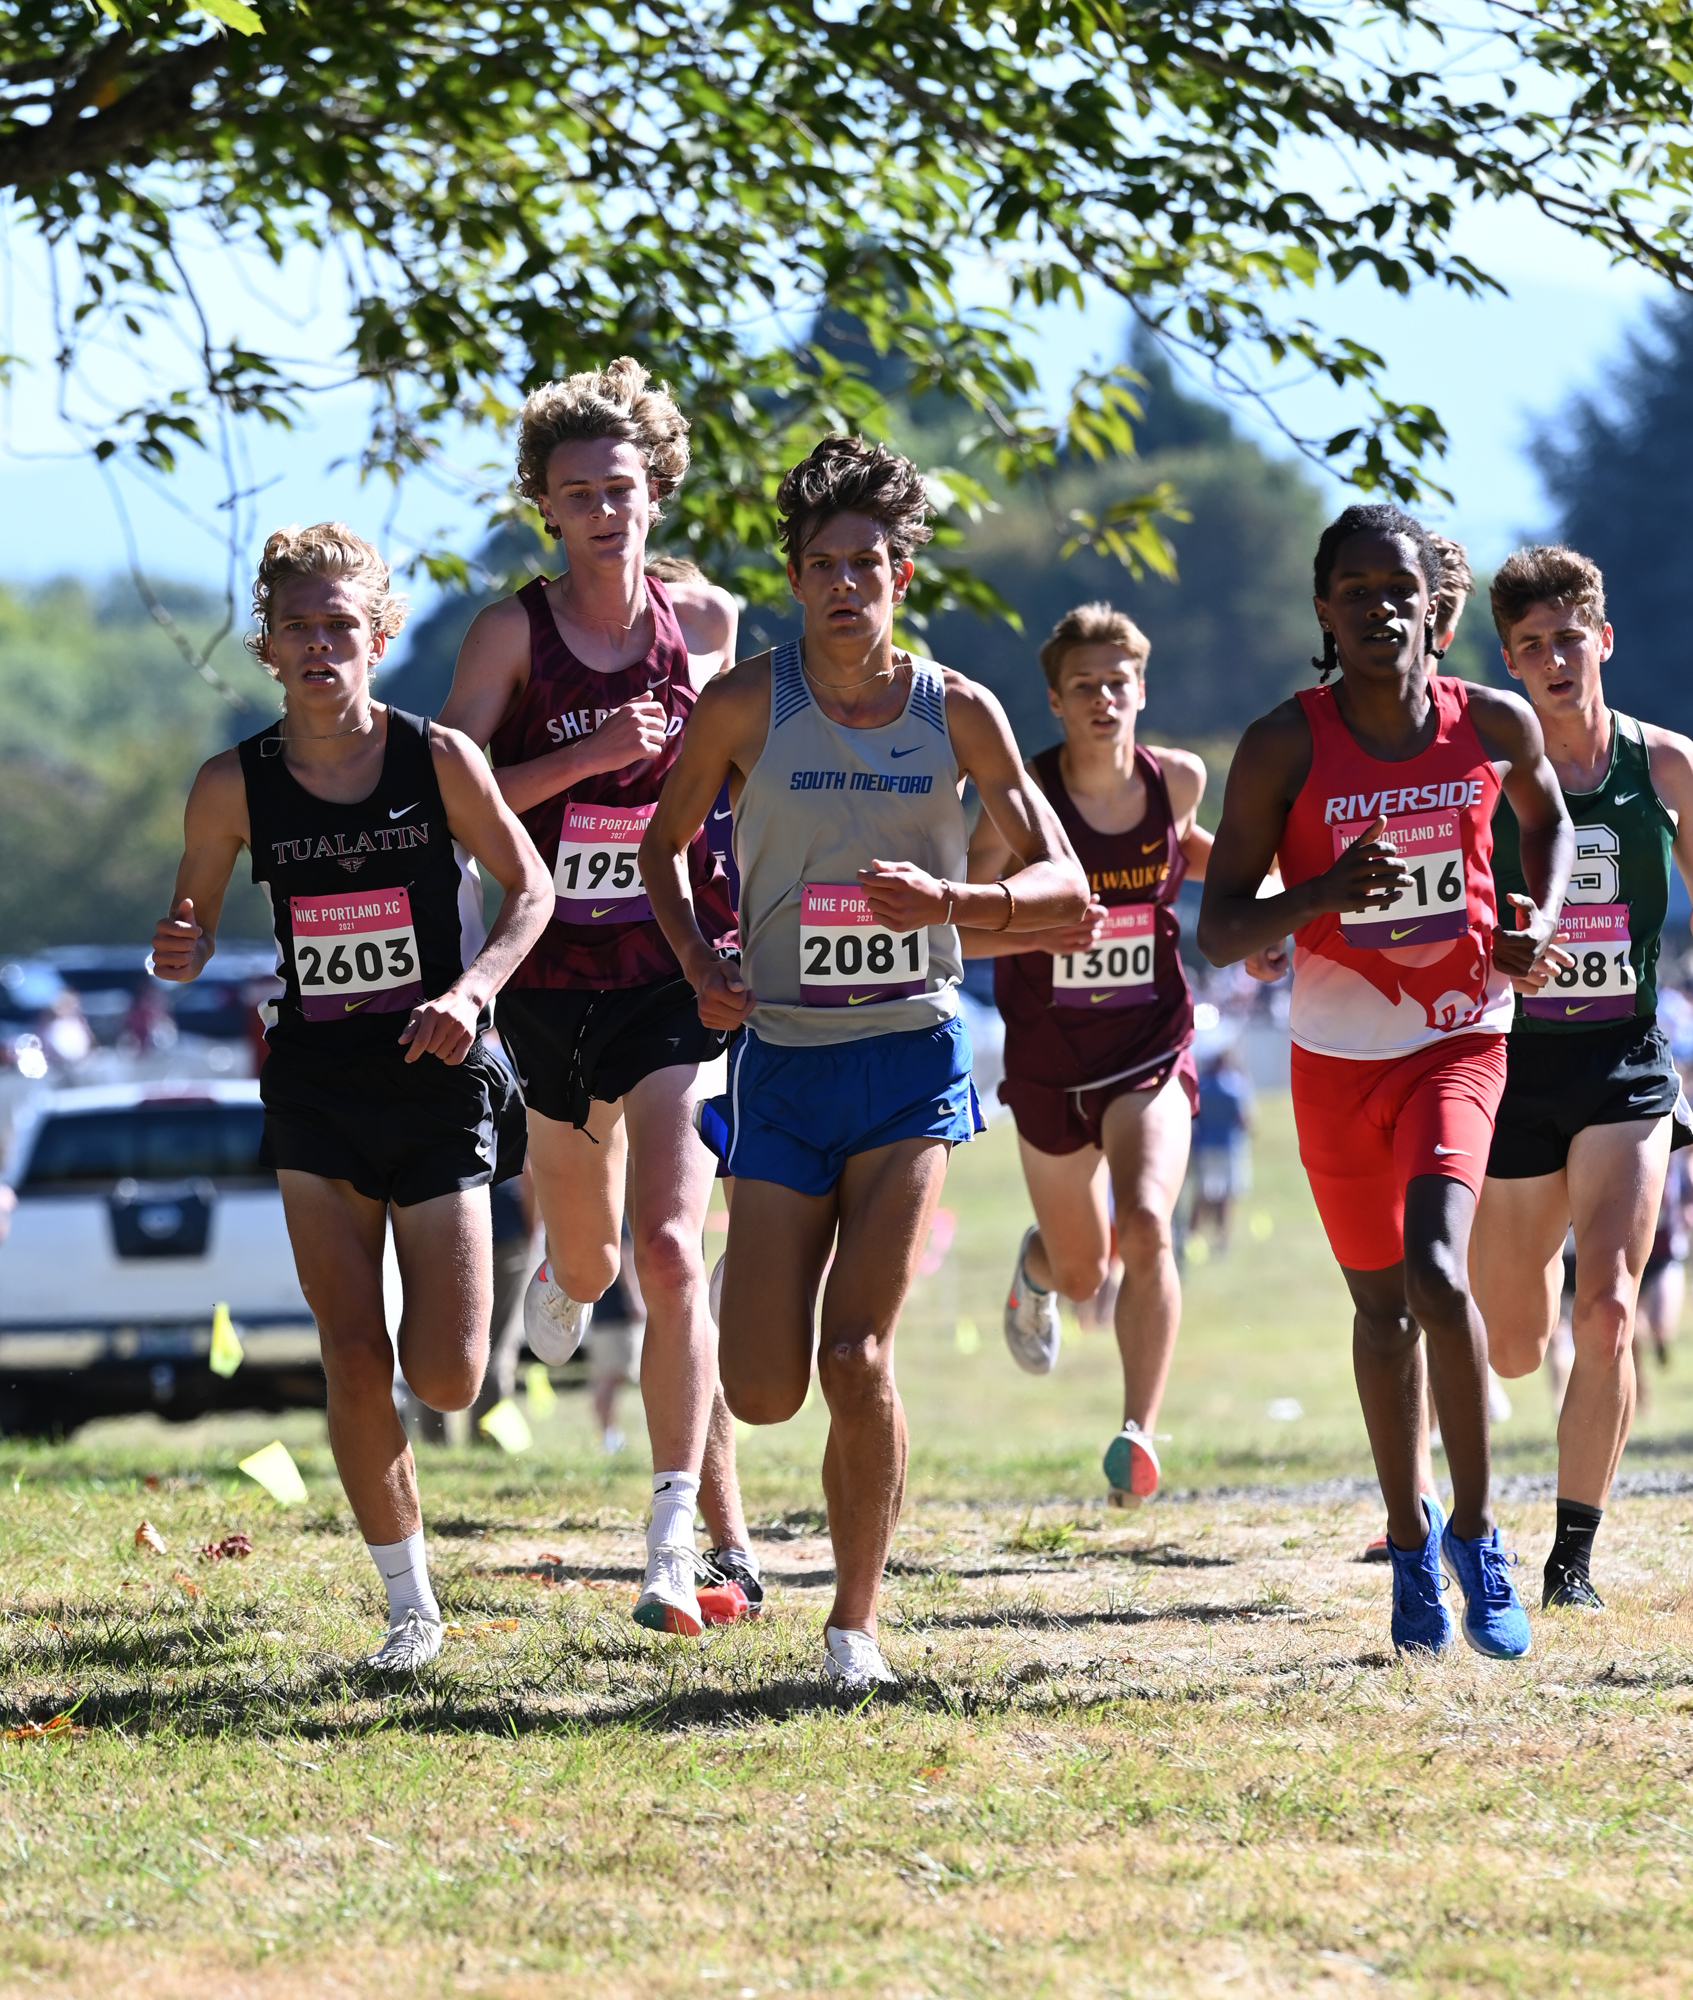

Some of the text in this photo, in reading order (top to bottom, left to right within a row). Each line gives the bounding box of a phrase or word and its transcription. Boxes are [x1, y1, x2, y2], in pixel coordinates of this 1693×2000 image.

[790, 771, 933, 794] SOUTH MEDFORD
[1325, 780, 1484, 823] RIVERSIDE
[569, 815, 596, 830] NIKE
[1438, 823, 1453, 837] XC
[272, 823, 429, 864] TUALATIN
[564, 851, 646, 889] 195
[1356, 860, 1462, 914] 16
[295, 901, 400, 923] NIKE PORTLAND XC
[808, 897, 836, 912] NIKE
[339, 922, 355, 931] 2021
[857, 914, 873, 922] 2021
[1558, 915, 1625, 930] PORTLAND XC
[1572, 931, 1586, 939] 2021
[298, 936, 414, 986] 2603
[804, 931, 920, 976] 2081
[1060, 944, 1150, 979] 1300
[1539, 950, 1629, 988] 881
